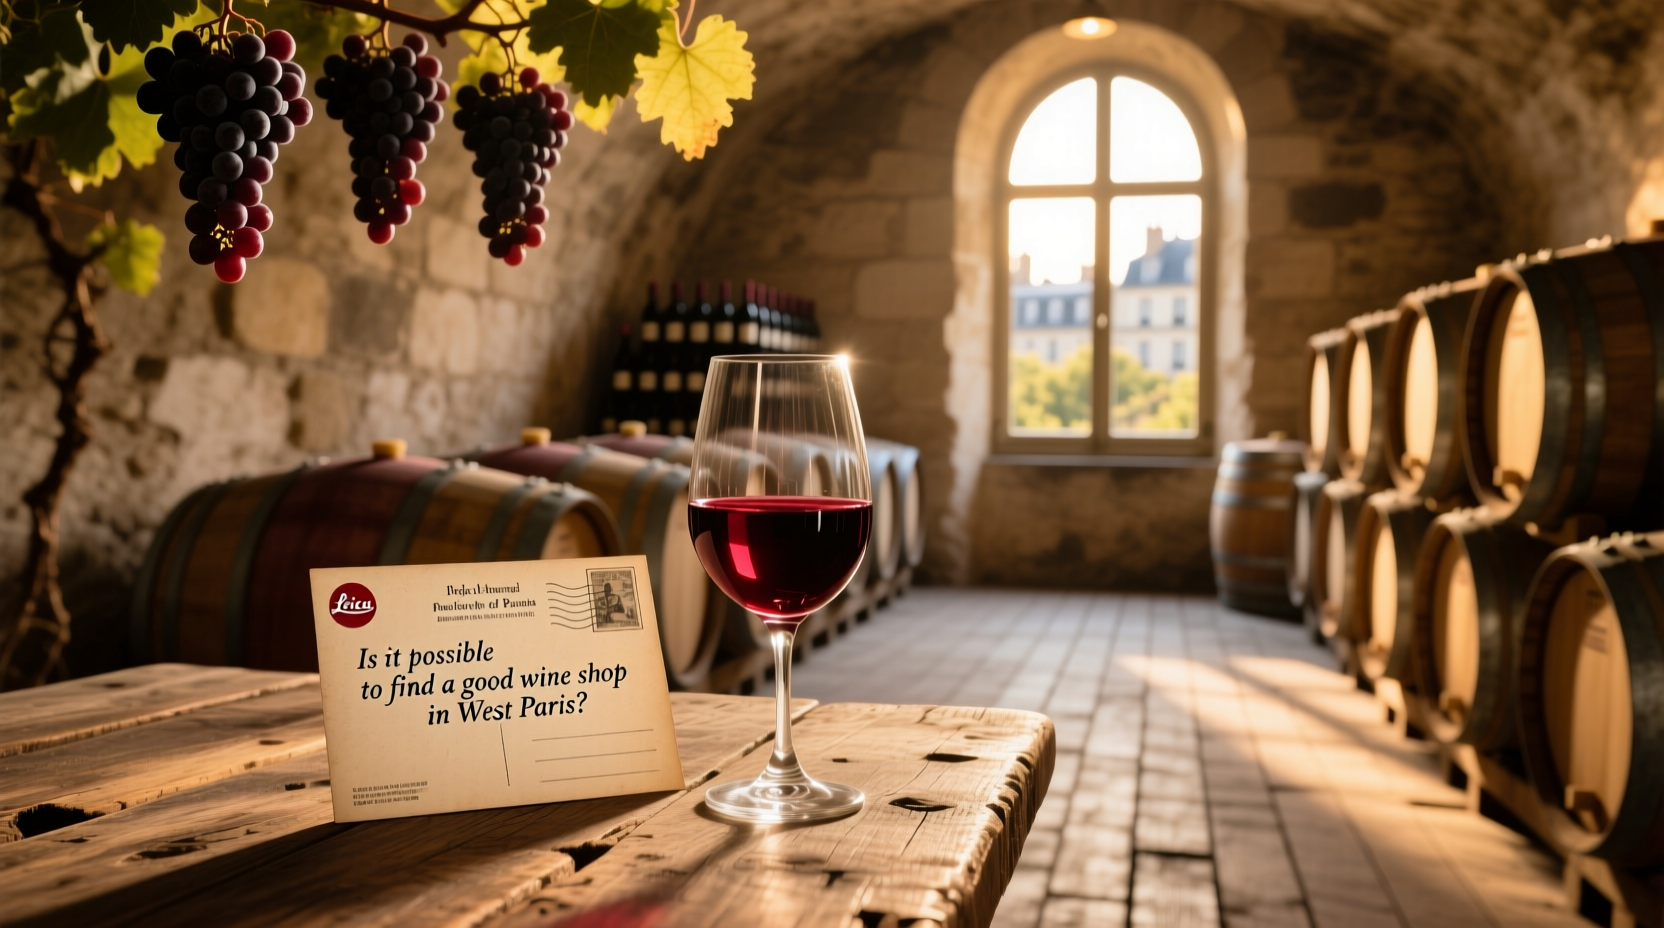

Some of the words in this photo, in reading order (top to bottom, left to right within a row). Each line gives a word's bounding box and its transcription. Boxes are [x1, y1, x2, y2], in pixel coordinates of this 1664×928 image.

[357, 647, 378, 670] Is
[385, 646, 402, 668] it
[407, 640, 494, 674] possible
[361, 681, 383, 700] to
[384, 672, 435, 707] find
[441, 679, 455, 694] a
[460, 667, 514, 700] good
[520, 669, 571, 690] wine
[577, 662, 627, 694] shop
[428, 704, 450, 726] in
[457, 699, 512, 723] West
[518, 691, 588, 719] Paris?
